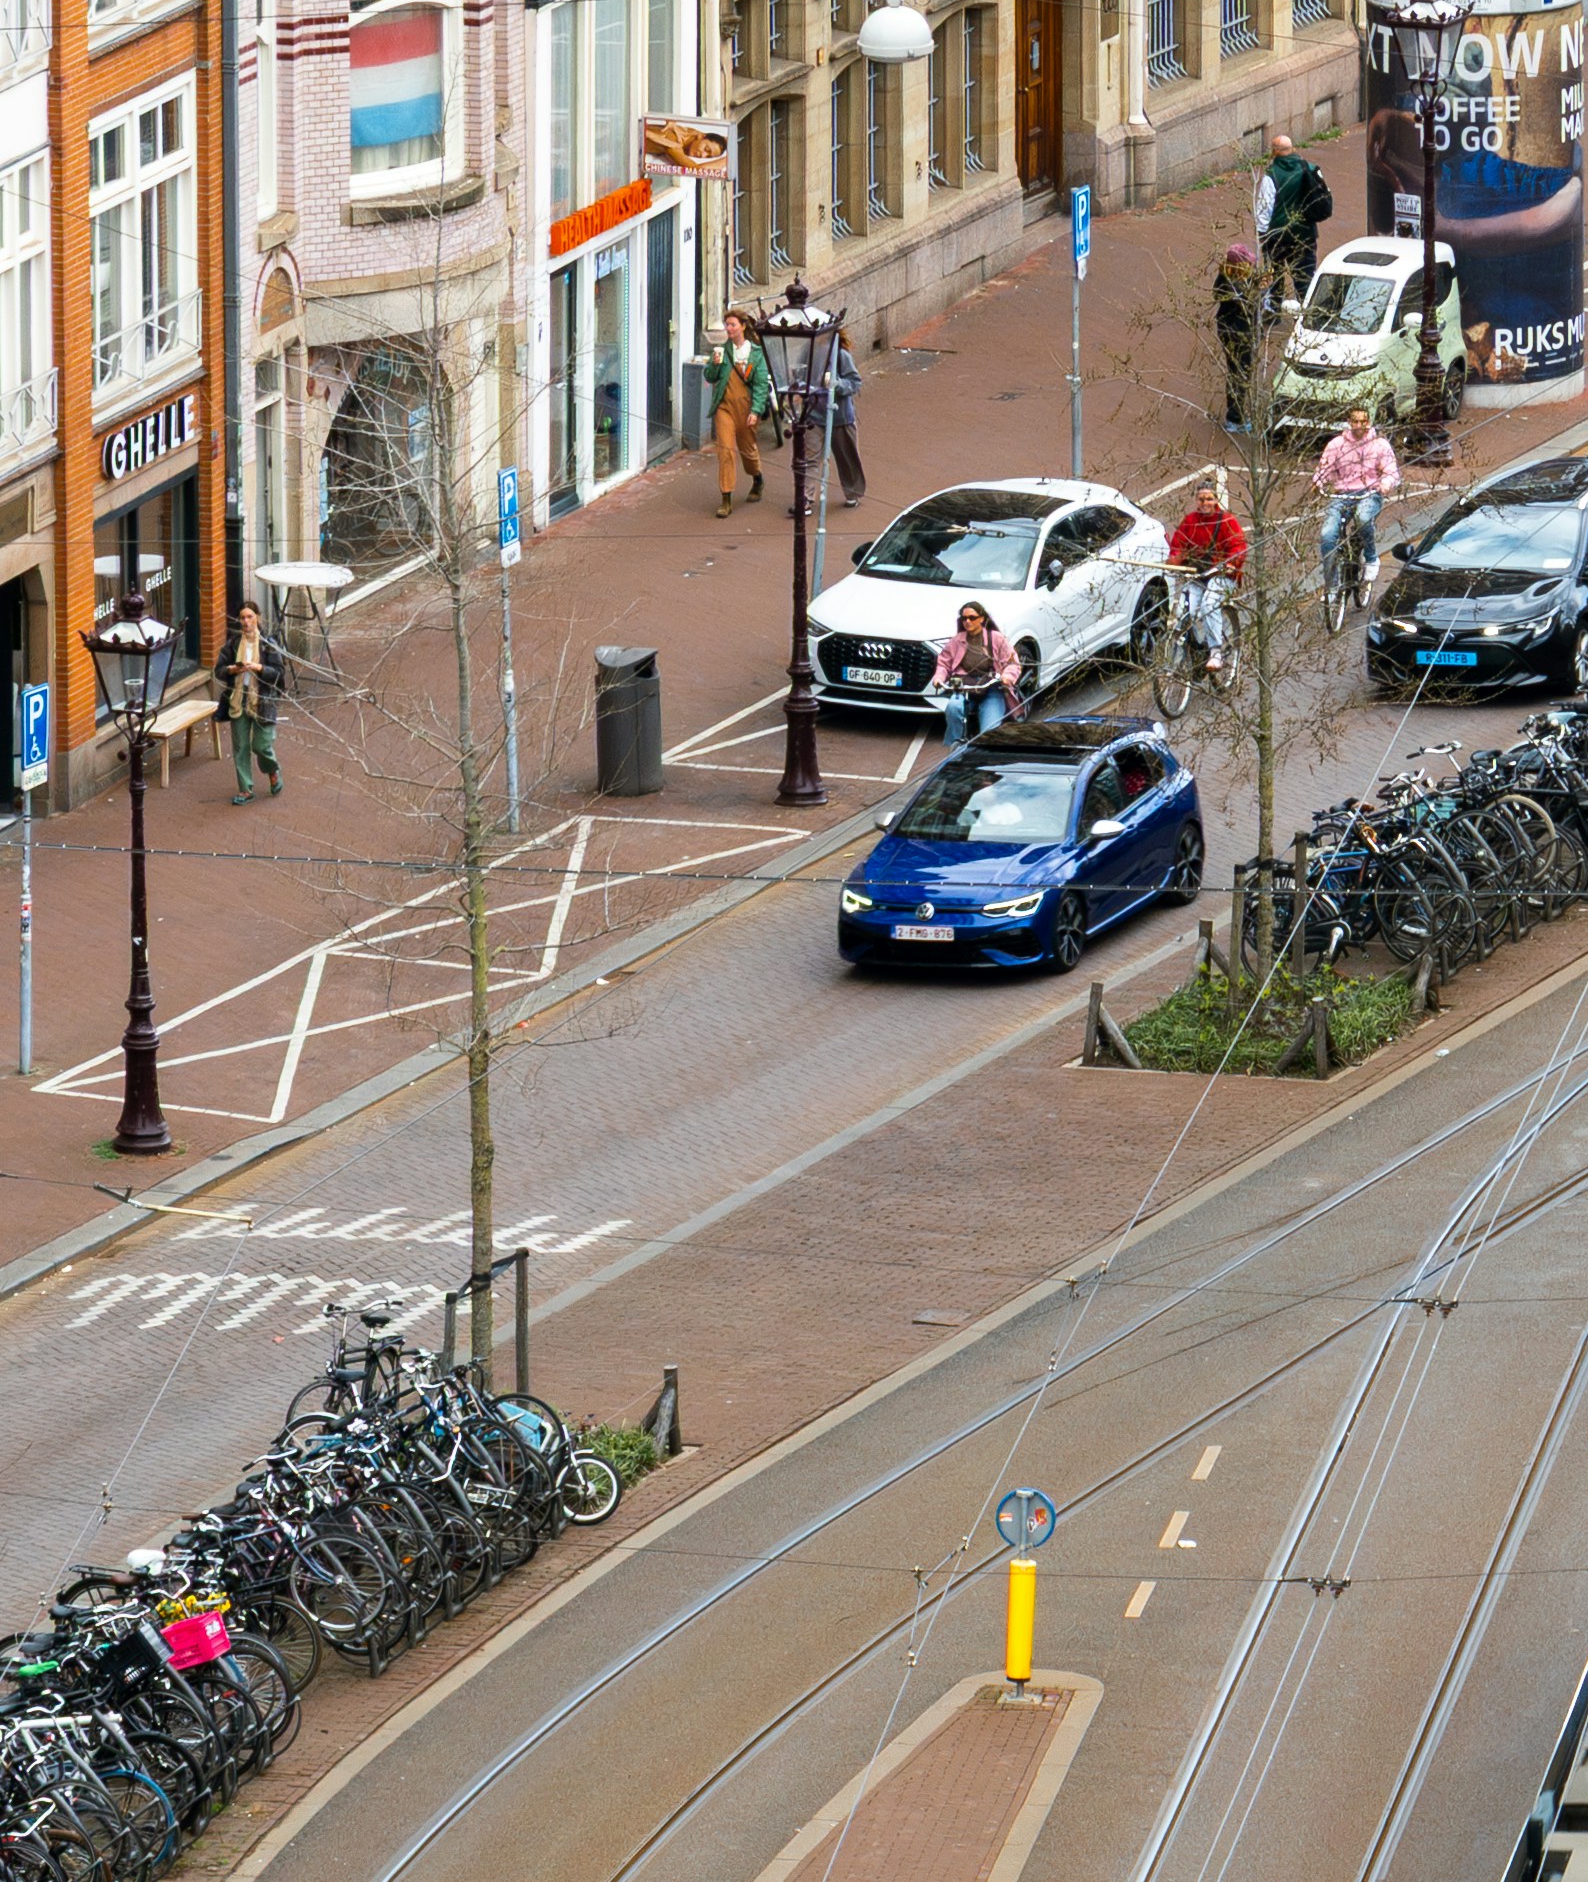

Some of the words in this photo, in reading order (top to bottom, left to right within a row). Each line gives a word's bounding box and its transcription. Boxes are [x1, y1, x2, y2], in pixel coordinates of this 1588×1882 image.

[1418, 29, 1545, 82] NOW
[1461, 126, 1503, 152] GO
[645, 164, 683, 174] CHINESE
[685, 167, 727, 178] MASSAGE
[558, 201, 604, 254] HEALTH
[604, 179, 652, 231] MASSAGE
[1078, 194, 1087, 230] P
[109, 394, 195, 479] GHELLE
[503, 475, 514, 514] P
[145, 566, 172, 592] GHELLE
[29, 693, 44, 735] P
